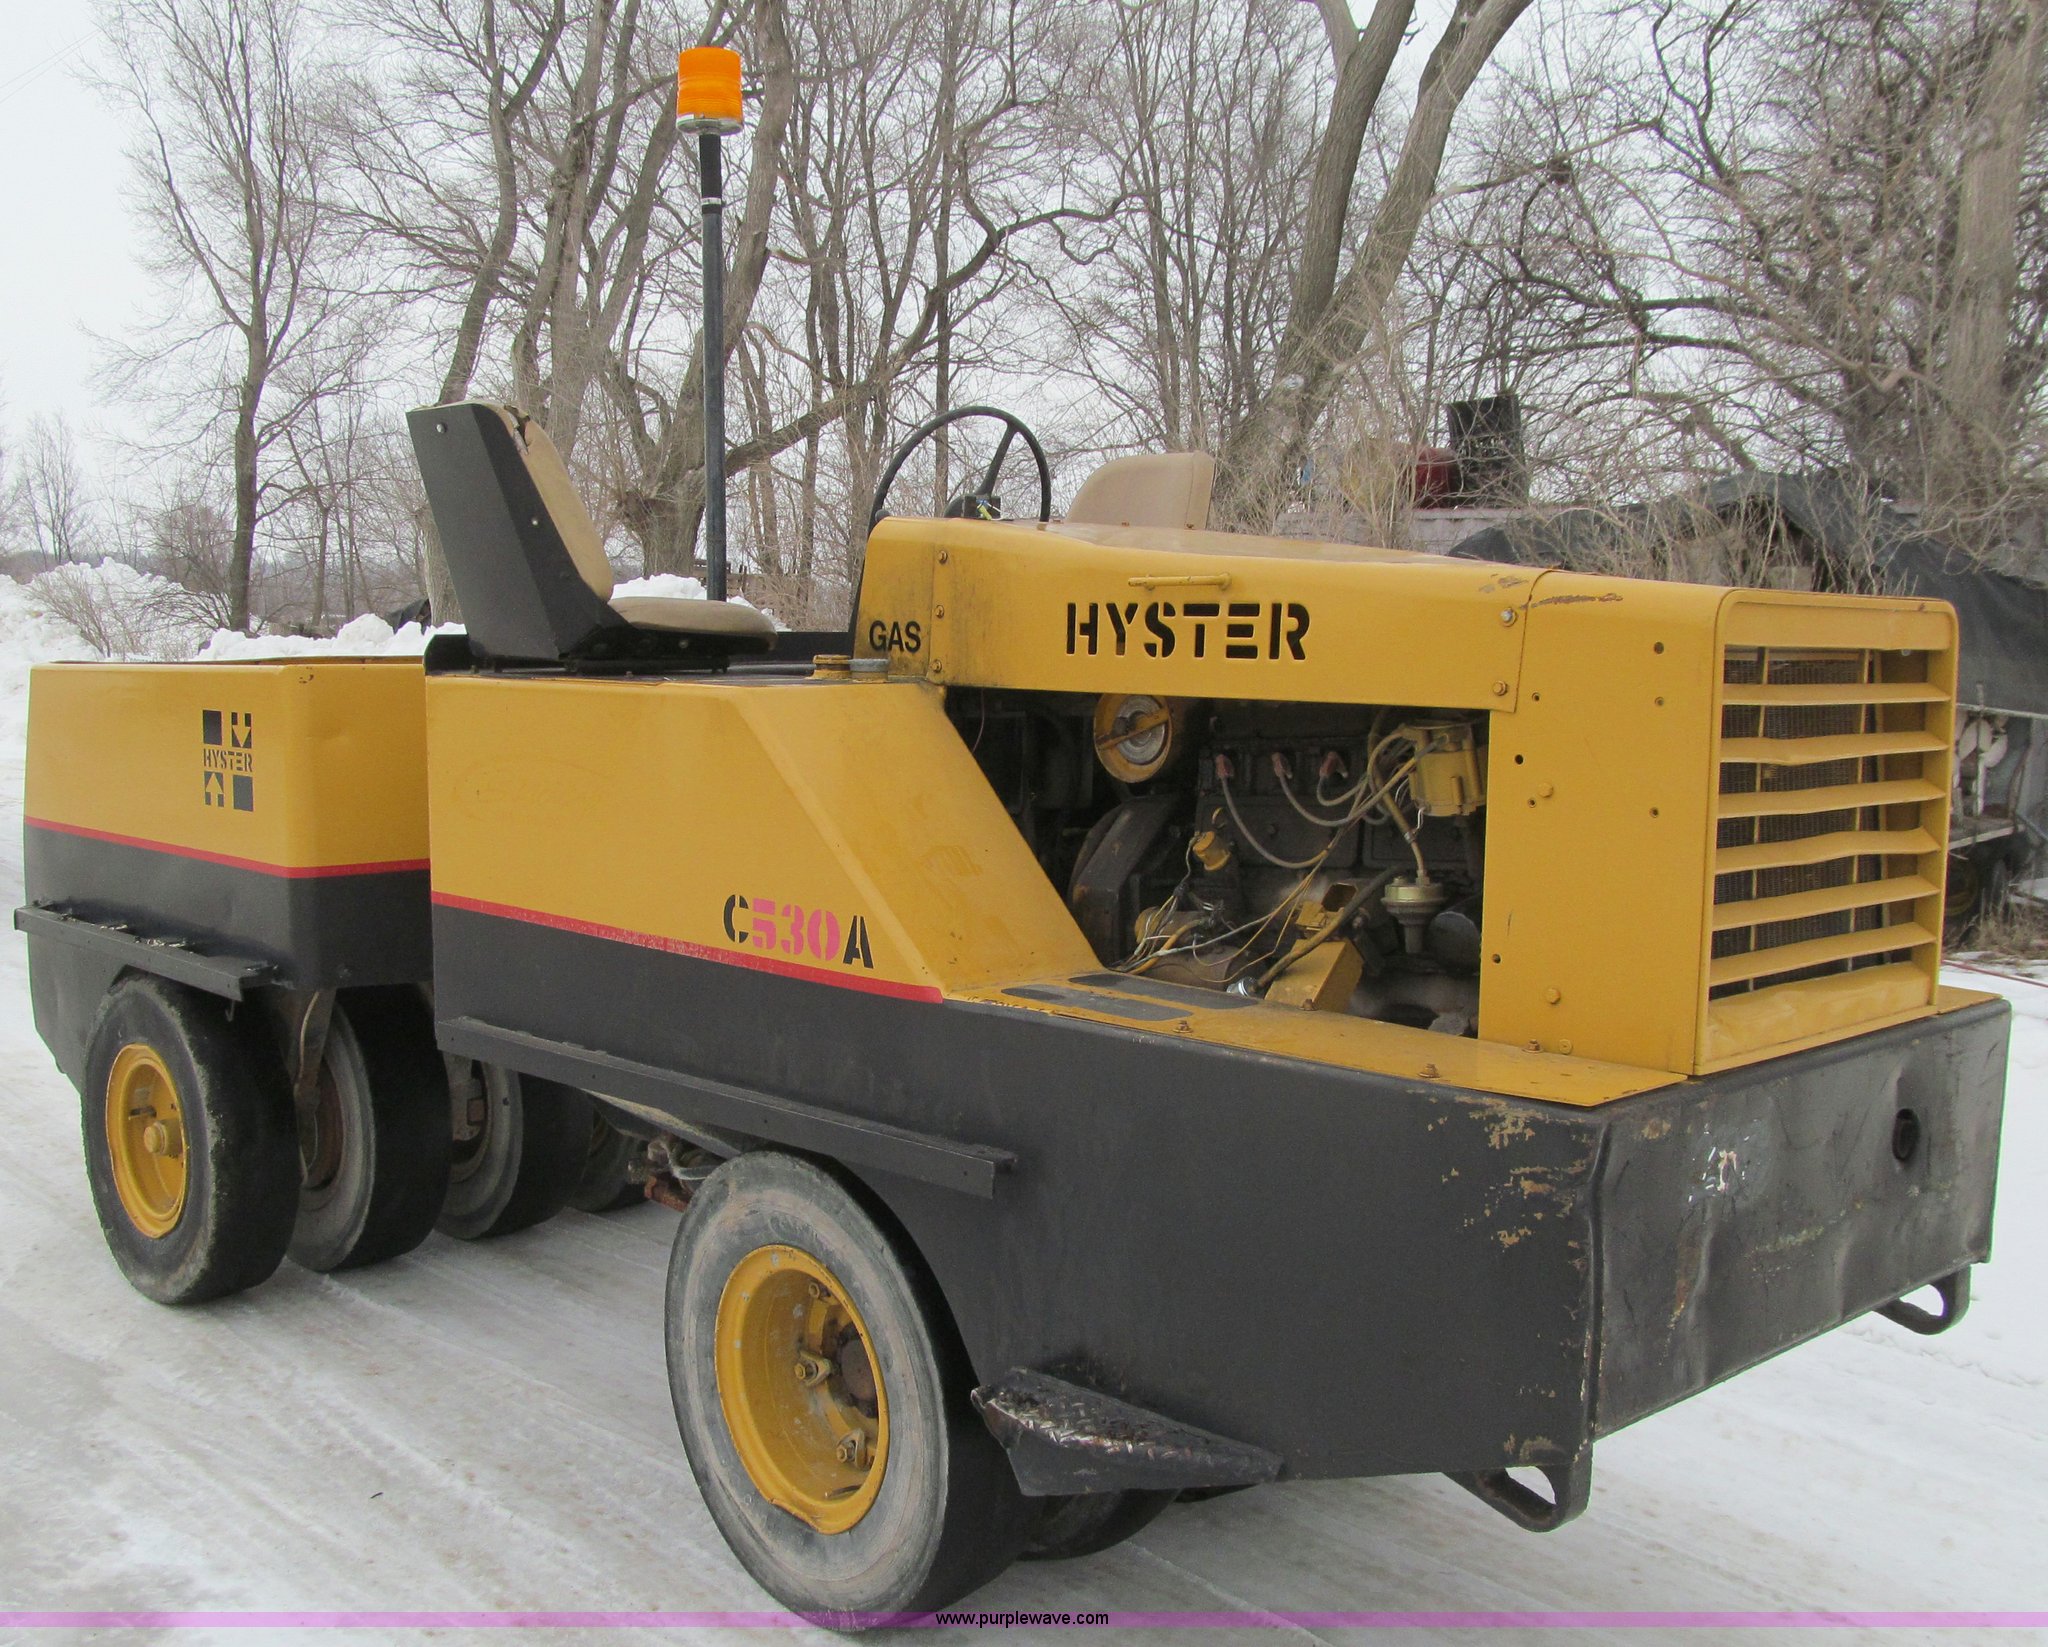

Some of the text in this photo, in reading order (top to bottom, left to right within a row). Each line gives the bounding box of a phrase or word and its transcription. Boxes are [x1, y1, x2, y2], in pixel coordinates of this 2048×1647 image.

[869, 620, 921, 652] GAS
[1066, 602, 1310, 660] HYSTER
[203, 749, 253, 772] HYSTER
[723, 894, 874, 969] C530A
